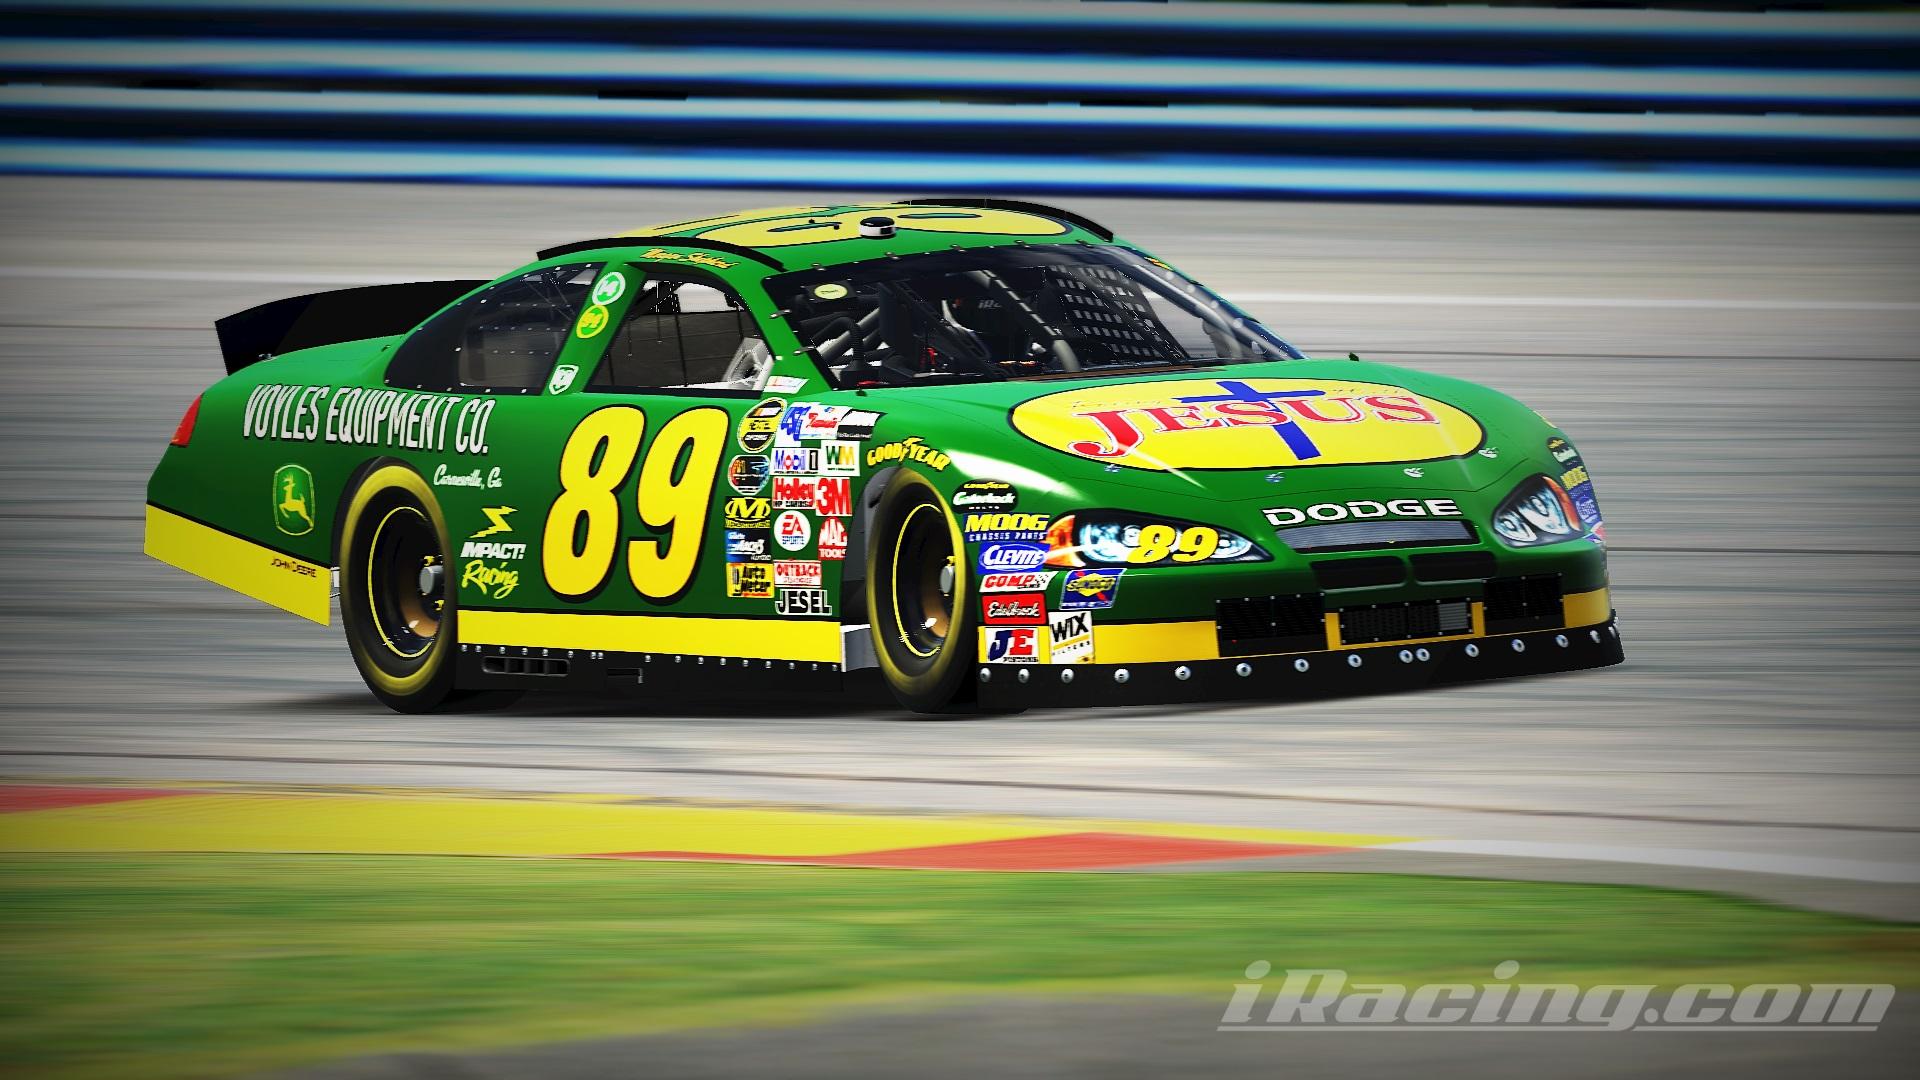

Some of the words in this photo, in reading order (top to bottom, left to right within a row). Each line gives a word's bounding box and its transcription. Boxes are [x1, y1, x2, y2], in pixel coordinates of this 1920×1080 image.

[243, 383, 331, 441] VOYLES
[325, 386, 464, 451] EQUIPMENT
[454, 398, 497, 454] CO.
[1067, 394, 1441, 459] JESUS
[773, 449, 806, 470] Mobil
[809, 449, 819, 471] 1
[825, 445, 855, 466] WM
[866, 436, 951, 472] GOODYEAR
[773, 477, 815, 501] Holley
[817, 477, 853, 516] 3M
[542, 404, 730, 603] 89
[1261, 498, 1463, 527] DODGE
[781, 514, 804, 535] EA
[964, 513, 1051, 533] MOOG
[460, 541, 527, 560] IMPACT!
[983, 544, 1045, 566] CLEVITE
[1127, 524, 1220, 563] 89
[461, 559, 520, 600] Racing
[776, 563, 818, 577] OUTBACK
[984, 574, 1036, 589] COMP
[775, 589, 833, 614] JESEL
[1049, 612, 1089, 643] WIX
[987, 628, 1035, 662] JE
